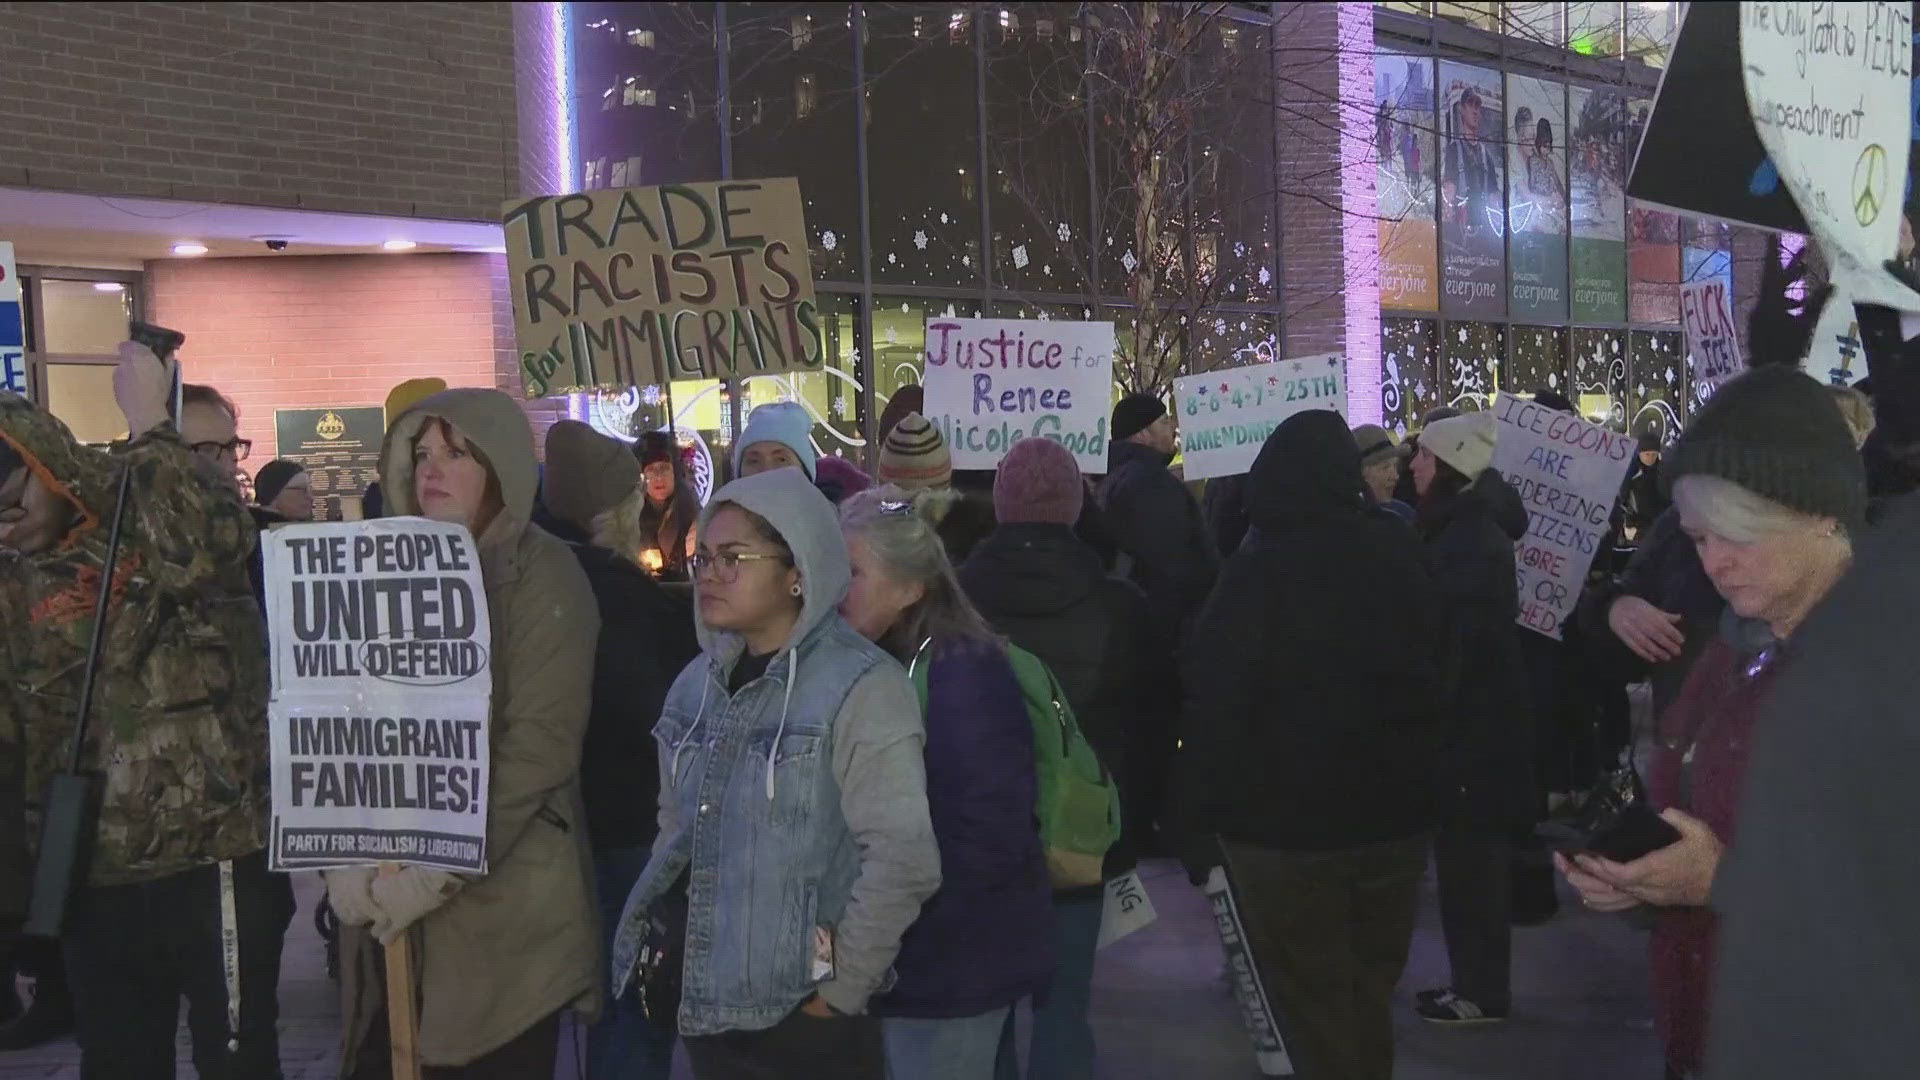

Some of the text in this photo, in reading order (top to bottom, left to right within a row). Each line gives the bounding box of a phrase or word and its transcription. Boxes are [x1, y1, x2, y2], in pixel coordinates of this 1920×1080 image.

[1843, 9, 1855, 57] to
[1863, 2, 1909, 77] PEACE
[503, 184, 766, 259] TRADE
[523, 240, 800, 324] RACISTS
[1379, 275, 1427, 300] veryone
[1445, 279, 1496, 304] everyone
[1513, 284, 1560, 308] everyone
[1574, 289, 1618, 312] everyone
[1683, 283, 1733, 337] FUCK
[522, 301, 824, 396] for IMMIGRANTS
[927, 322, 1106, 370] Justice for
[972, 373, 1072, 415] Renee
[1285, 374, 1337, 402] 25TH
[1032, 414, 1106, 456] Good
[1186, 419, 1280, 452] AMENDME
[1524, 446, 1574, 480] ARE
[285, 533, 470, 575] THE PEOPLE
[291, 576, 476, 642] UNITED
[293, 642, 479, 678] WILL DEFEND
[289, 717, 481, 760] IMMIGRANT
[291, 762, 480, 814] FAMILIES!
[287, 834, 479, 860] PARTY FOR SOCIALISM & LIBERATION
